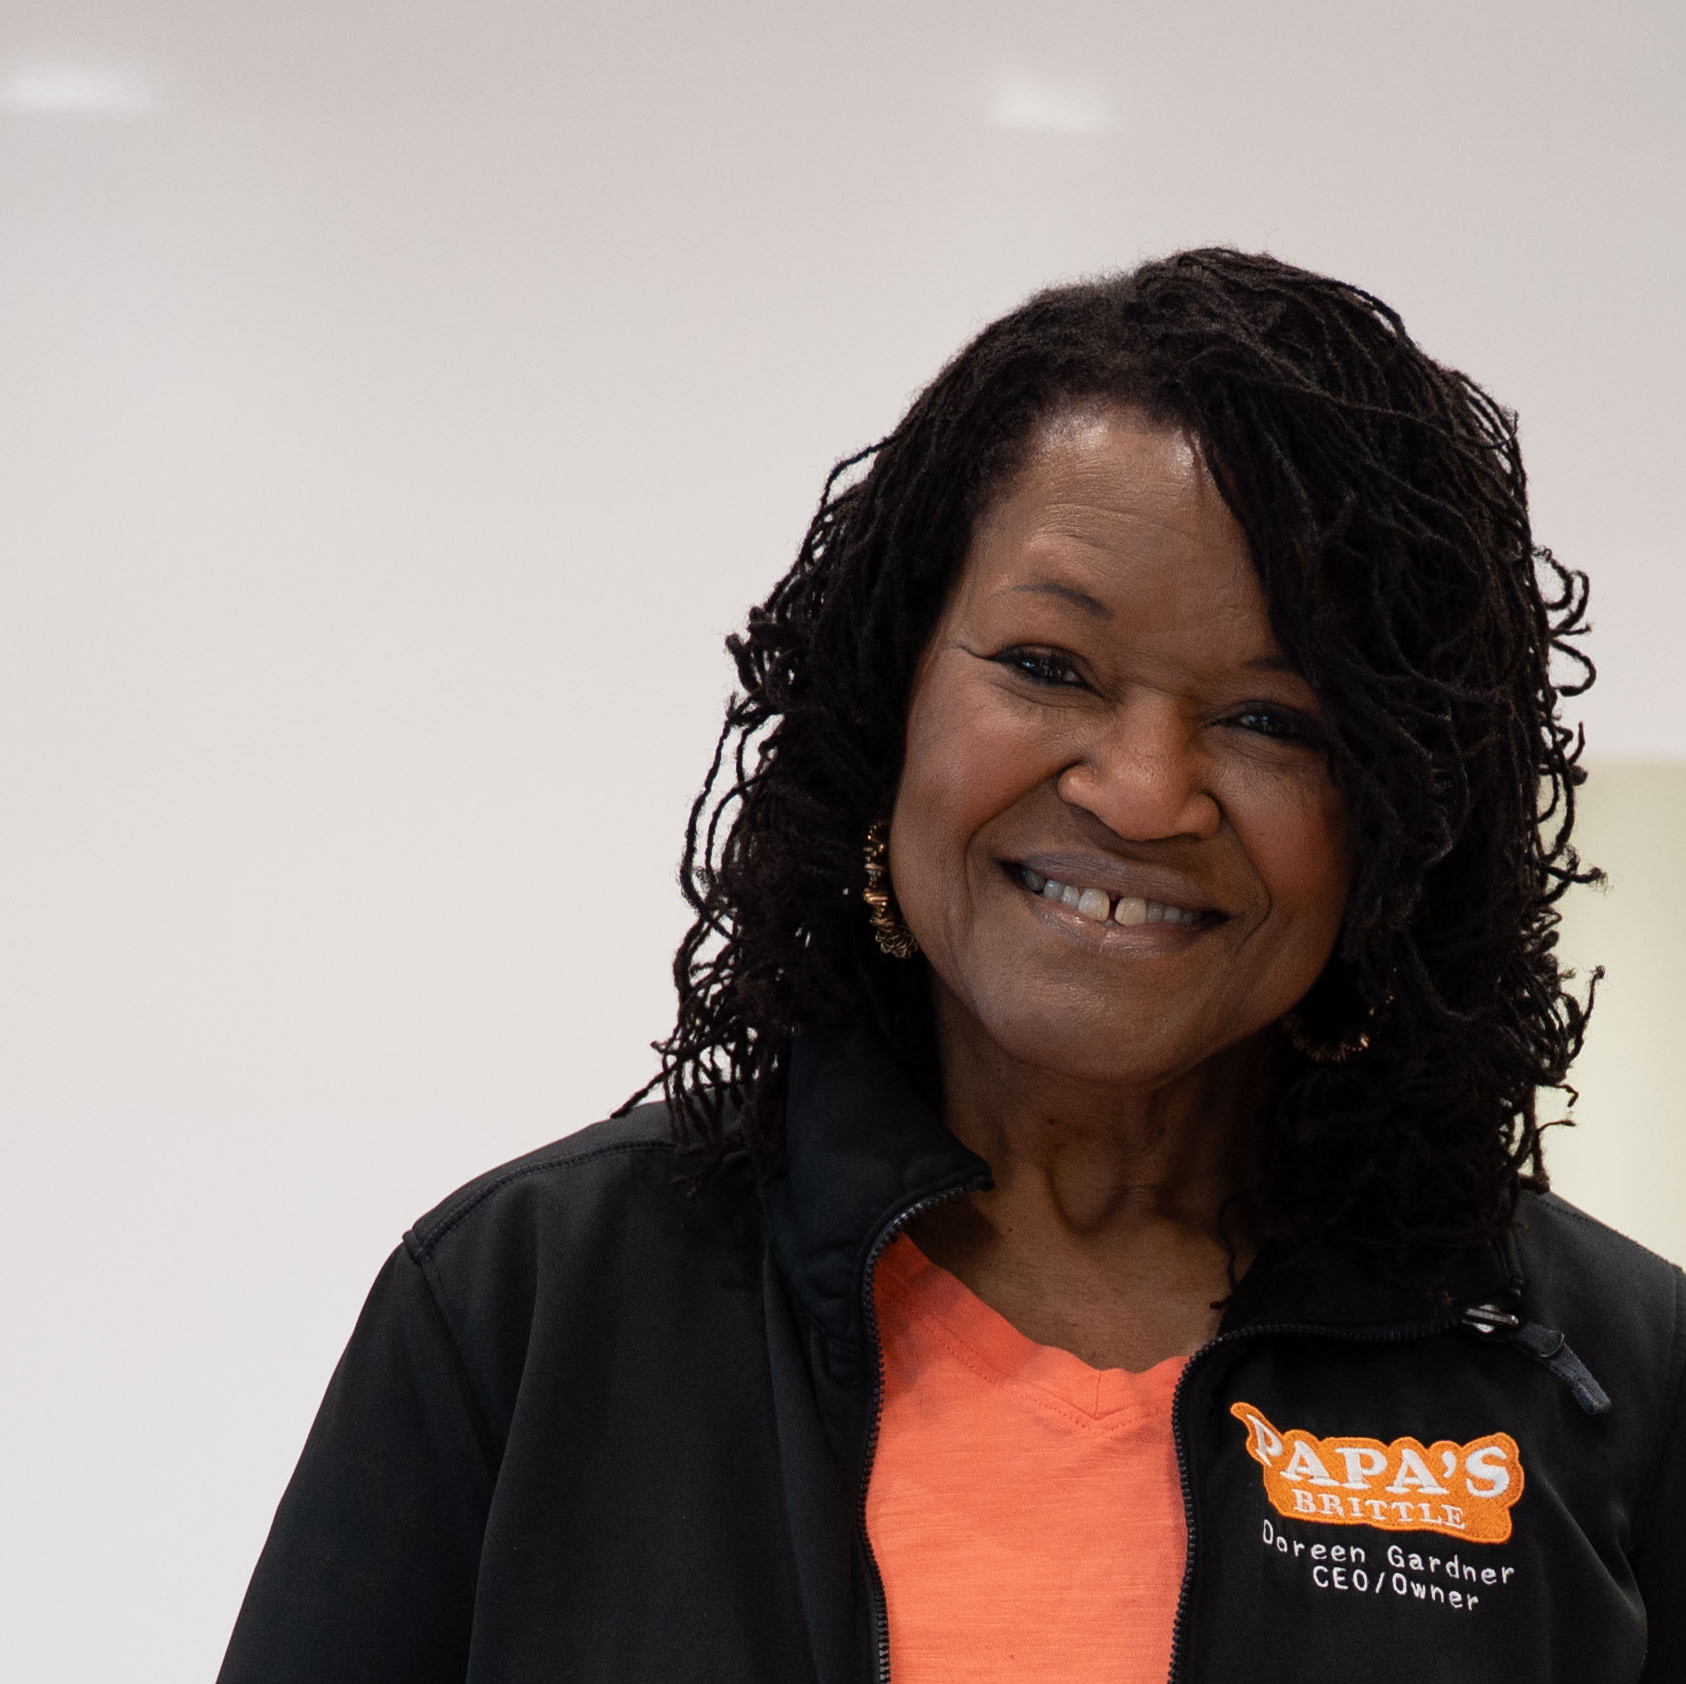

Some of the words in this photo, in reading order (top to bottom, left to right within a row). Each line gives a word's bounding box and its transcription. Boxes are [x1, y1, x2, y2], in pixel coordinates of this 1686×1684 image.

[1246, 1413, 1511, 1498] PAPA'S
[1291, 1489, 1466, 1529] BRITTLE
[1263, 1519, 1366, 1564] Doreen
[1387, 1545, 1514, 1586] Gardner
[1313, 1565, 1480, 1611] CEO/Owner
